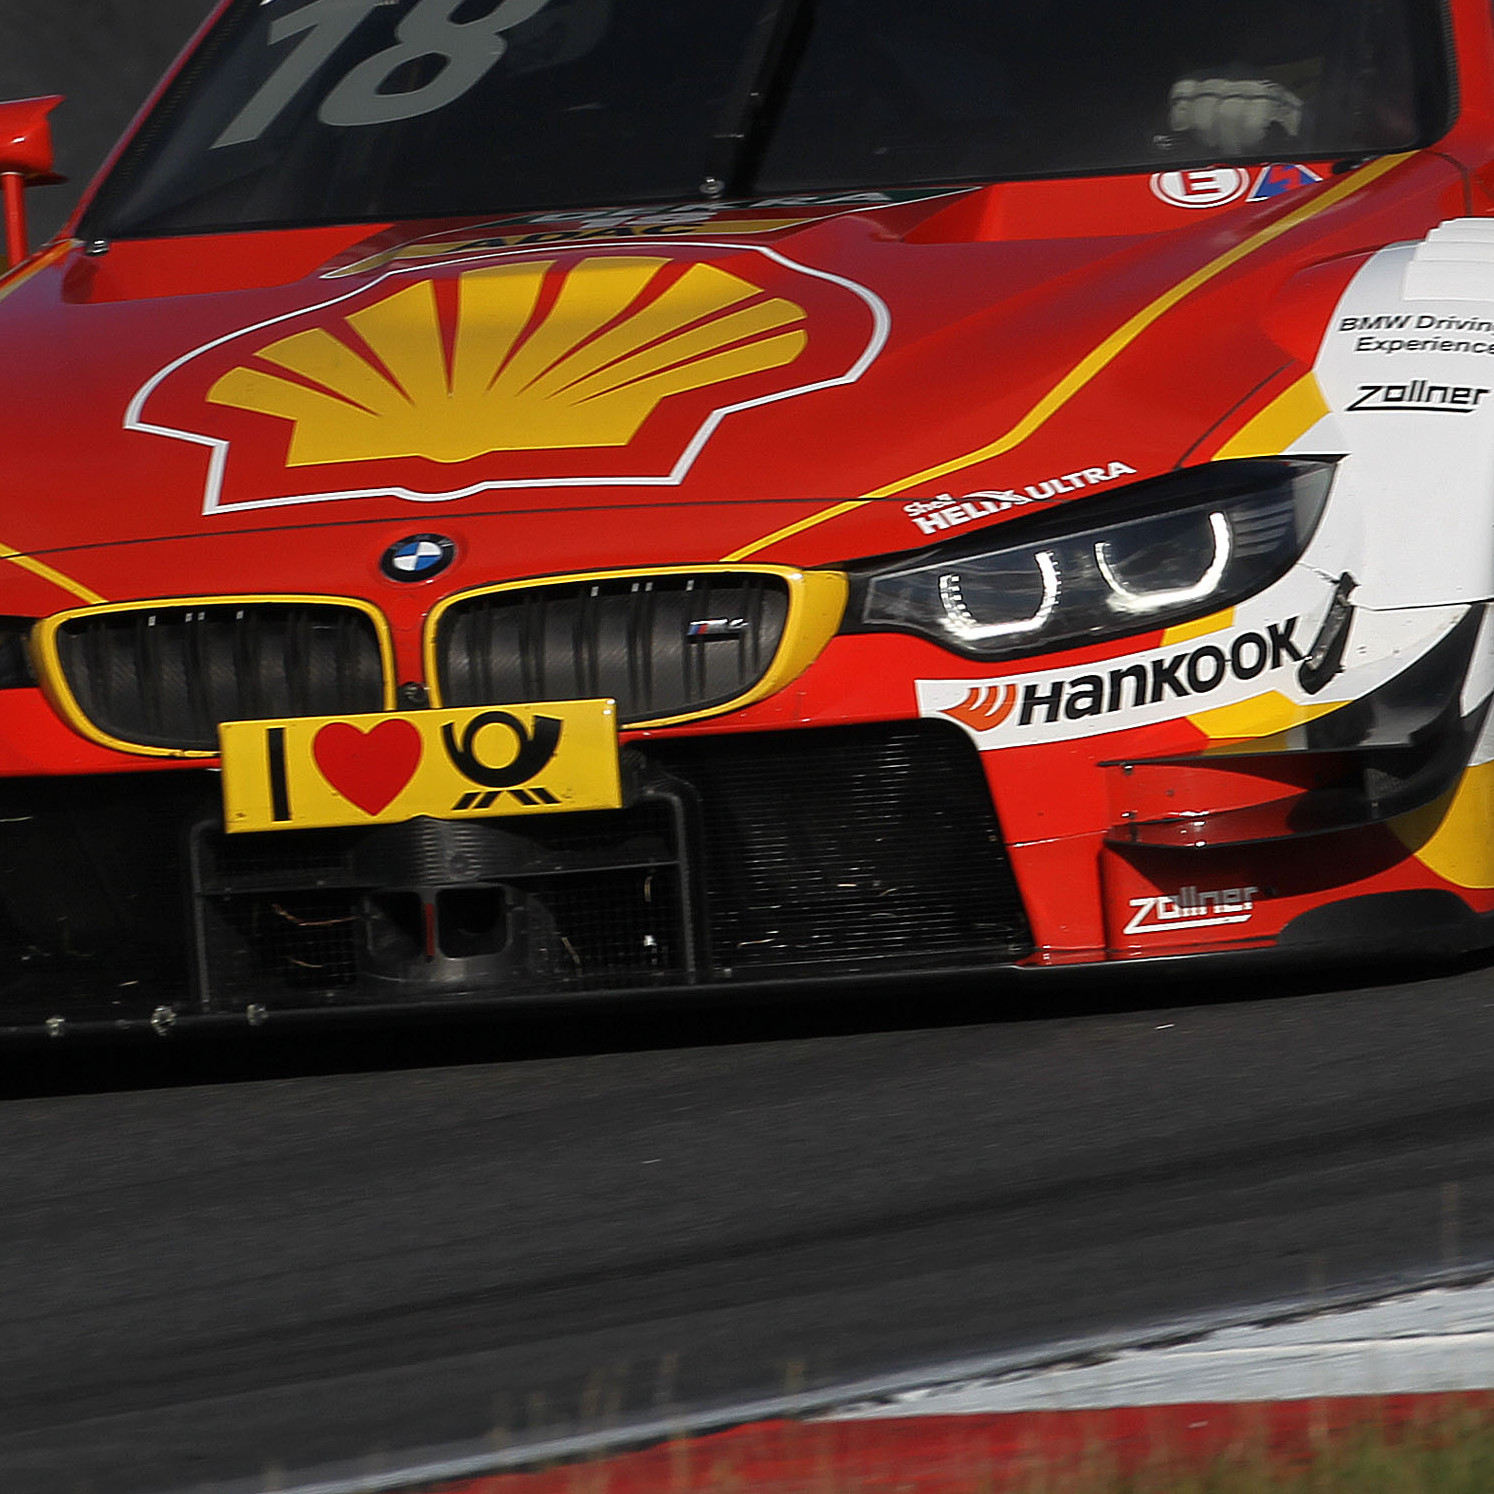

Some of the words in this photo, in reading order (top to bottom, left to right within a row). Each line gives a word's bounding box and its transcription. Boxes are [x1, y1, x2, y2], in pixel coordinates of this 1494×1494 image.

[577, 210, 721, 231] 18
[444, 223, 705, 253] ADAC
[1338, 314, 1411, 332] BMW
[912, 487, 1026, 535] HELIX
[1023, 461, 1138, 505] ULTRA
[266, 726, 292, 823] I
